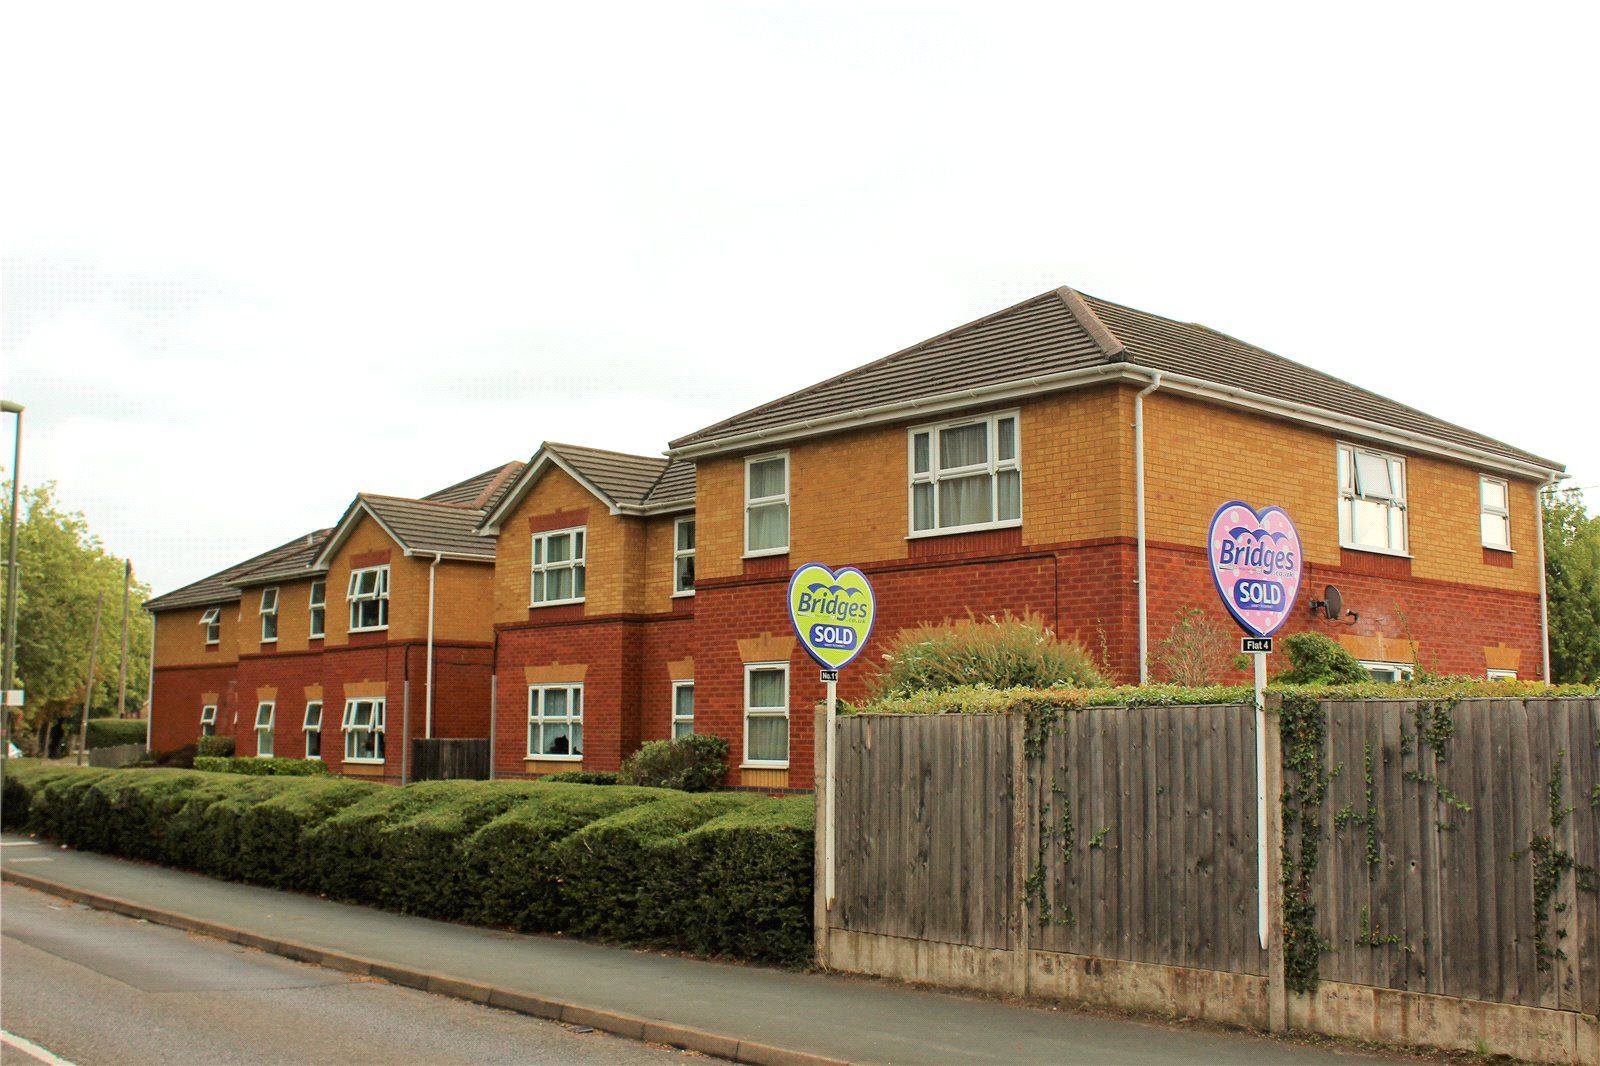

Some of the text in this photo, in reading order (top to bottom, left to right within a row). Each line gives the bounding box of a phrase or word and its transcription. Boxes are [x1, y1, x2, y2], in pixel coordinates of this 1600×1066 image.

[1219, 538, 1294, 574] Bridges
[1240, 582, 1280, 605] SOLD
[798, 592, 867, 621] Bridges
[815, 625, 853, 645] SOLD
[1247, 641, 1269, 650] Flat 4
